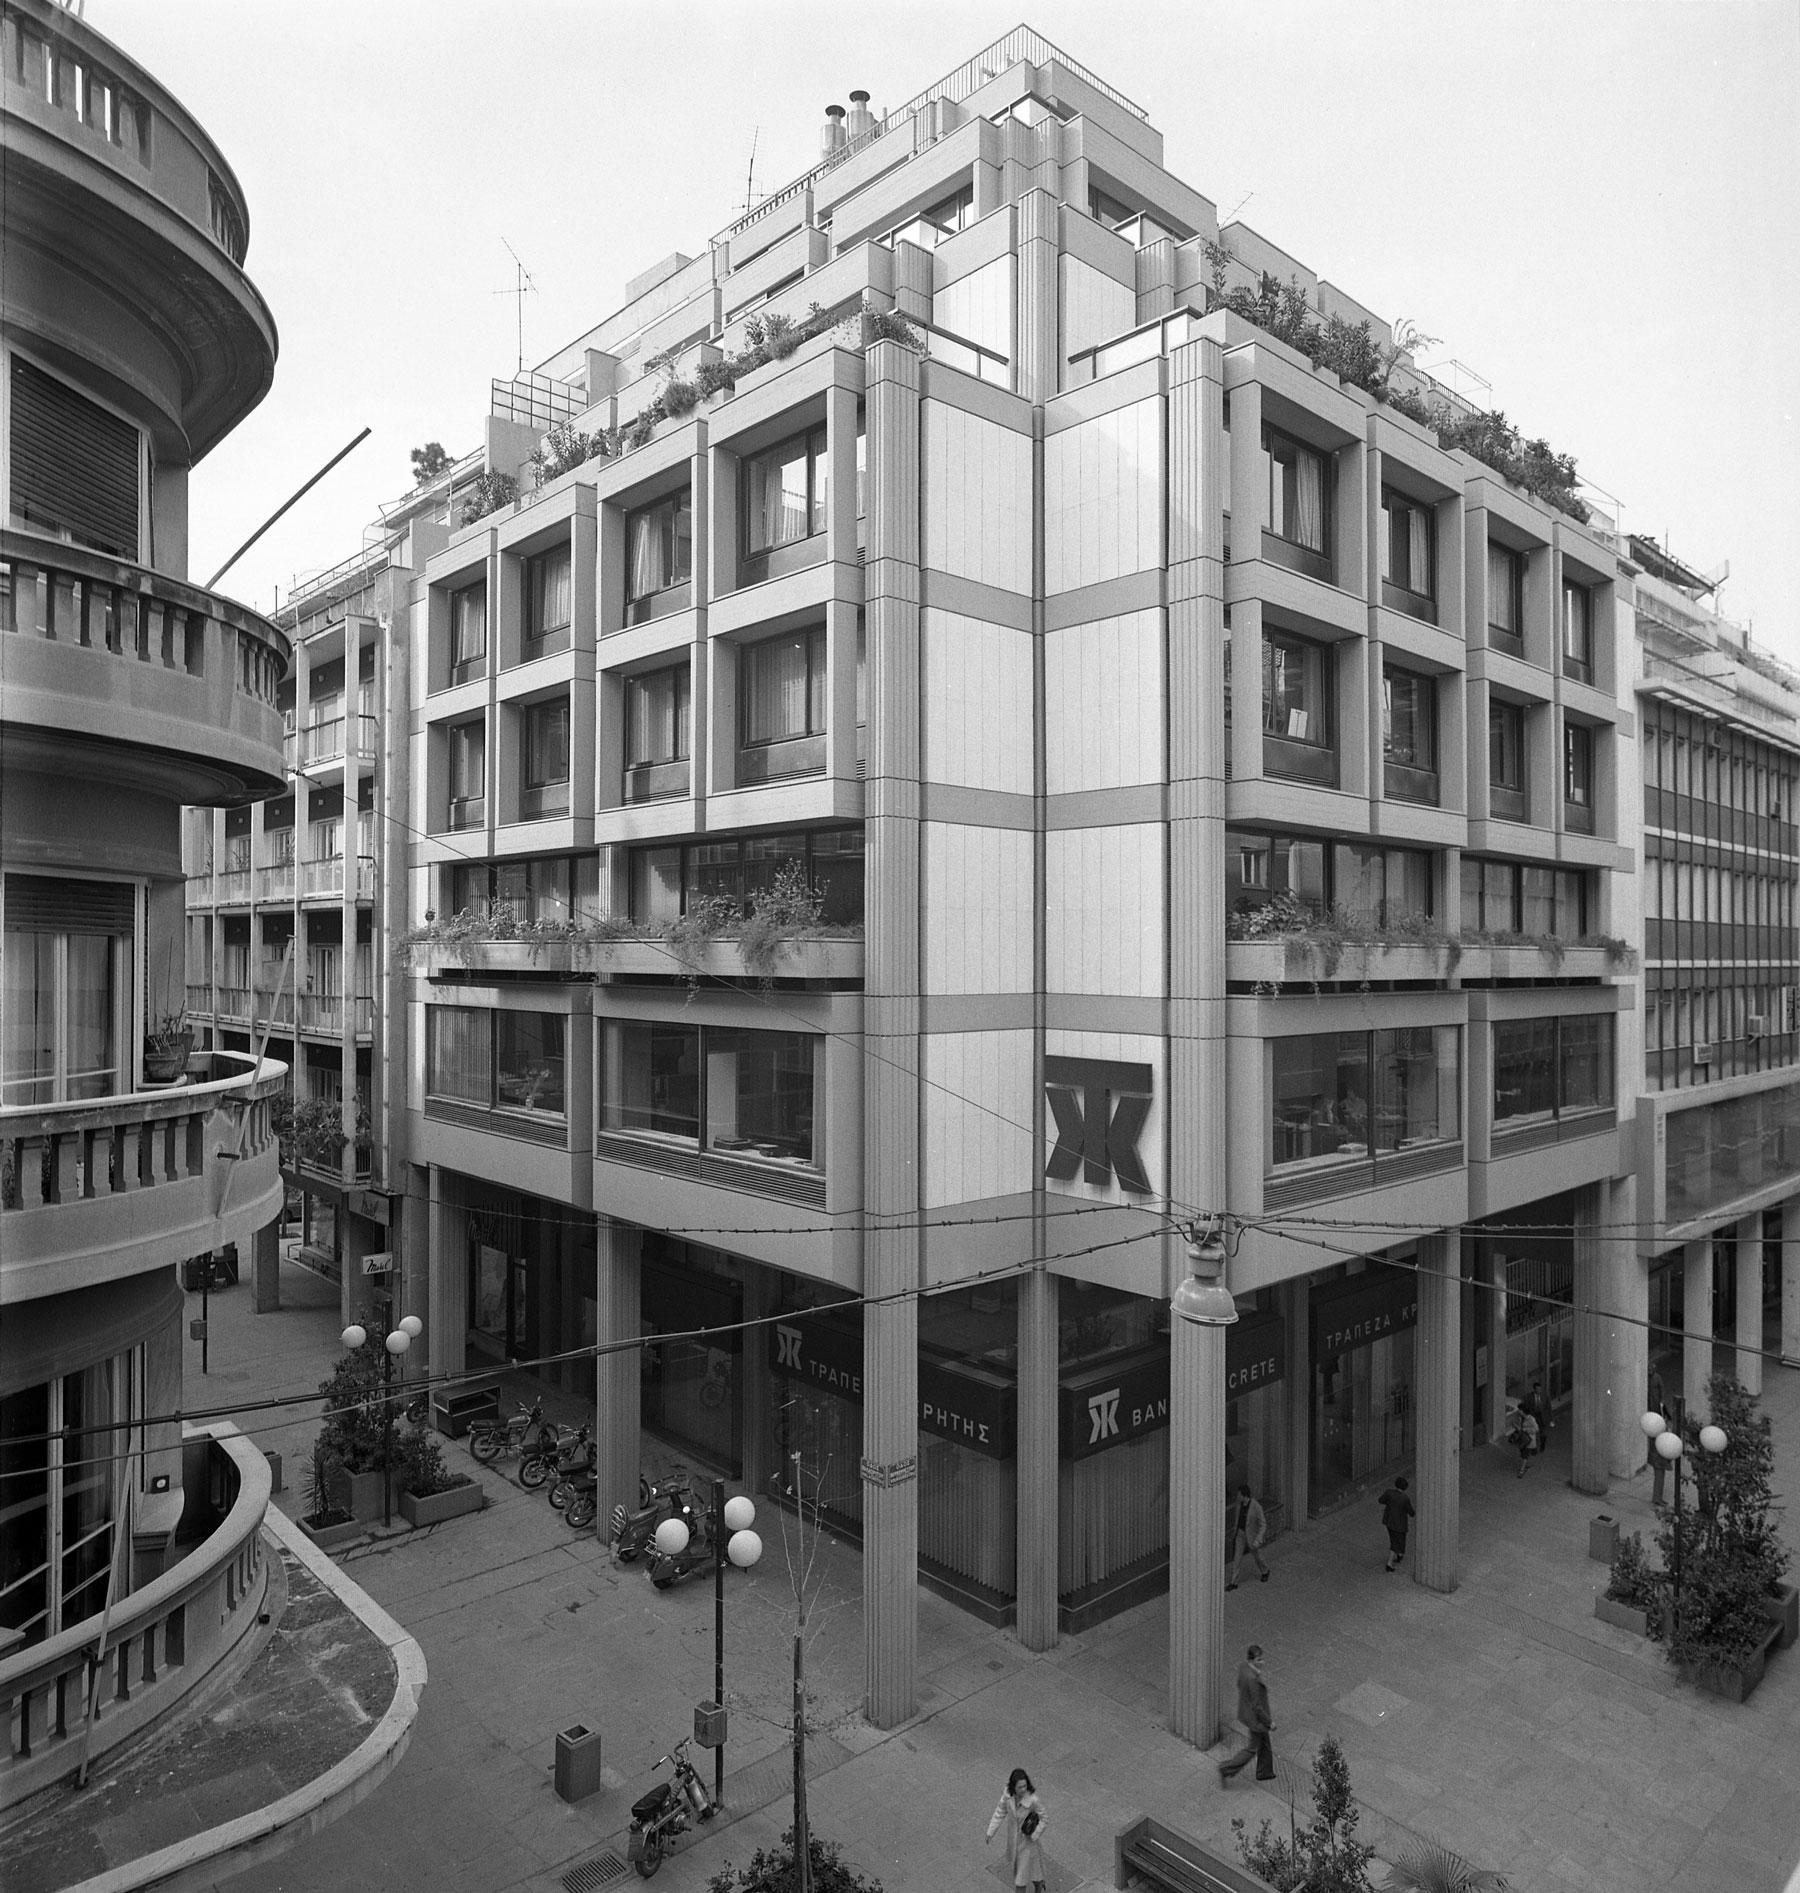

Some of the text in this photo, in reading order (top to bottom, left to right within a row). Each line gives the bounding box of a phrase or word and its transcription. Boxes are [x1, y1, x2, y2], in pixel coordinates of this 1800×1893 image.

[1402, 1303, 1417, 1321] ΚΡ
[809, 1360, 989, 1443] ΤΡΑΠΕ ΡΗΤΗΣ
[1132, 1357, 1276, 1428] BAN CRETE
